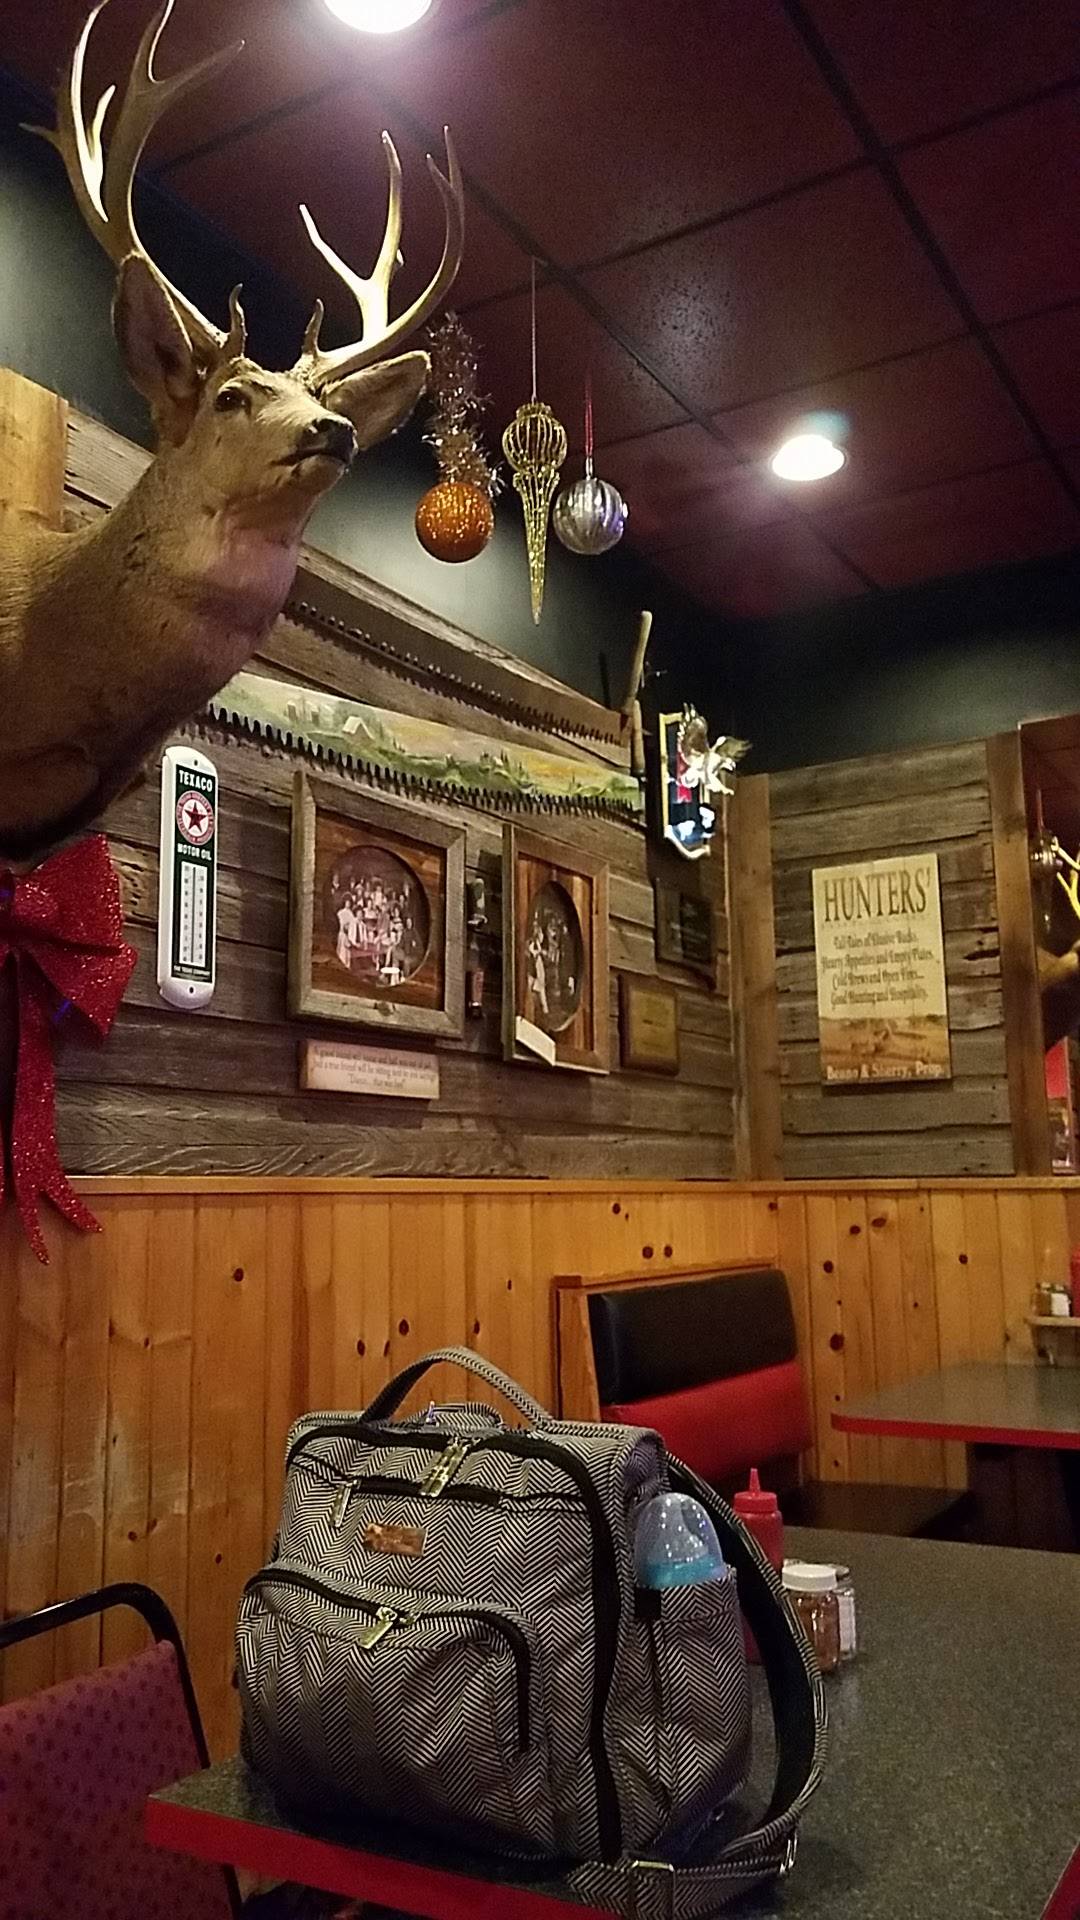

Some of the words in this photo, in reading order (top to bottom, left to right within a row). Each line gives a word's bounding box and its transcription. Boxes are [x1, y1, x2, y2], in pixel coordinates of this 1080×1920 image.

[179, 769, 213, 793] TEXACO
[177, 843, 200, 858] MOTOR
[201, 848, 212, 861] OIL
[824, 867, 931, 922] HUNTERS'
